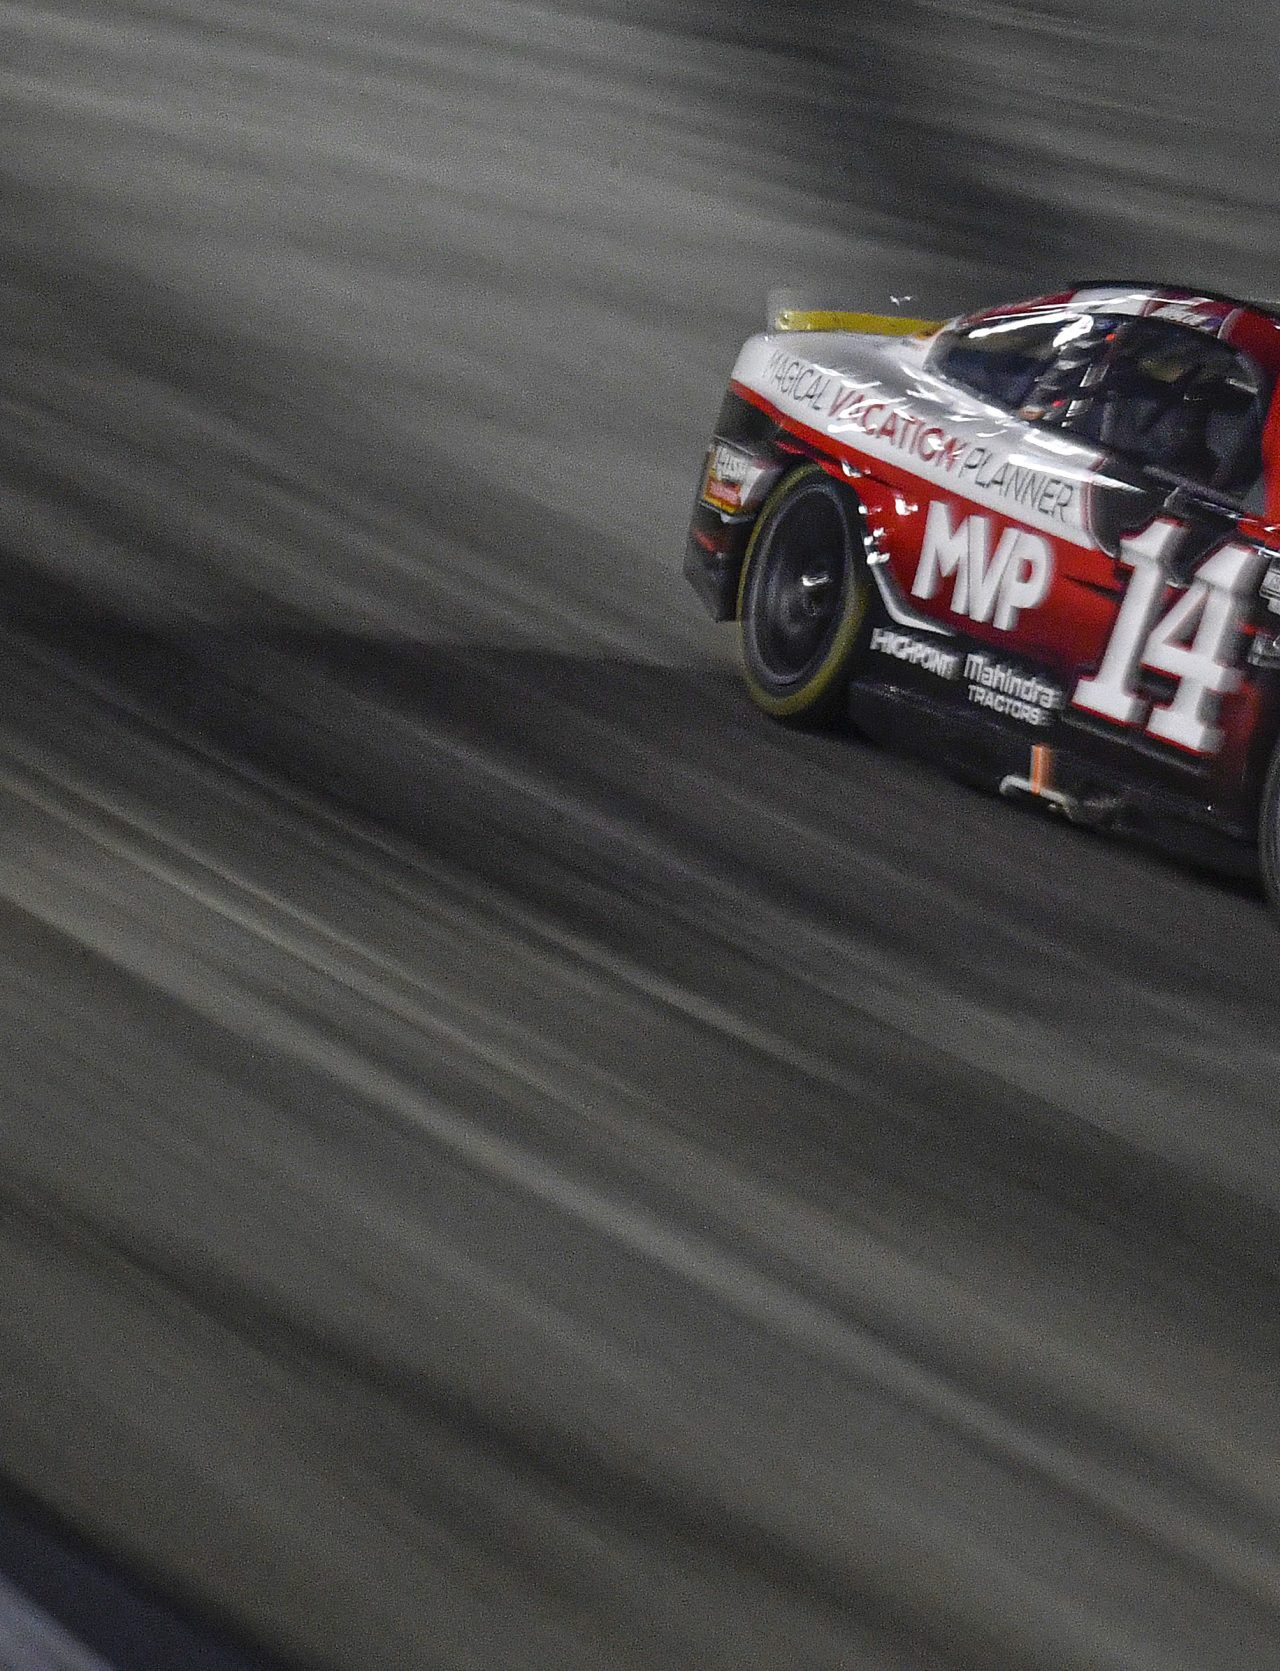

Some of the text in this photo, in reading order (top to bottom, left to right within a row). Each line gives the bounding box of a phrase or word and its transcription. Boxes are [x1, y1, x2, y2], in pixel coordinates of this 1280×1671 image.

[958, 447, 1074, 523] PLANNER
[910, 500, 1054, 631] MVP
[1071, 516, 1254, 756] 14
[963, 653, 1060, 709] Mahindra
[967, 684, 1045, 726] TRACTORS
